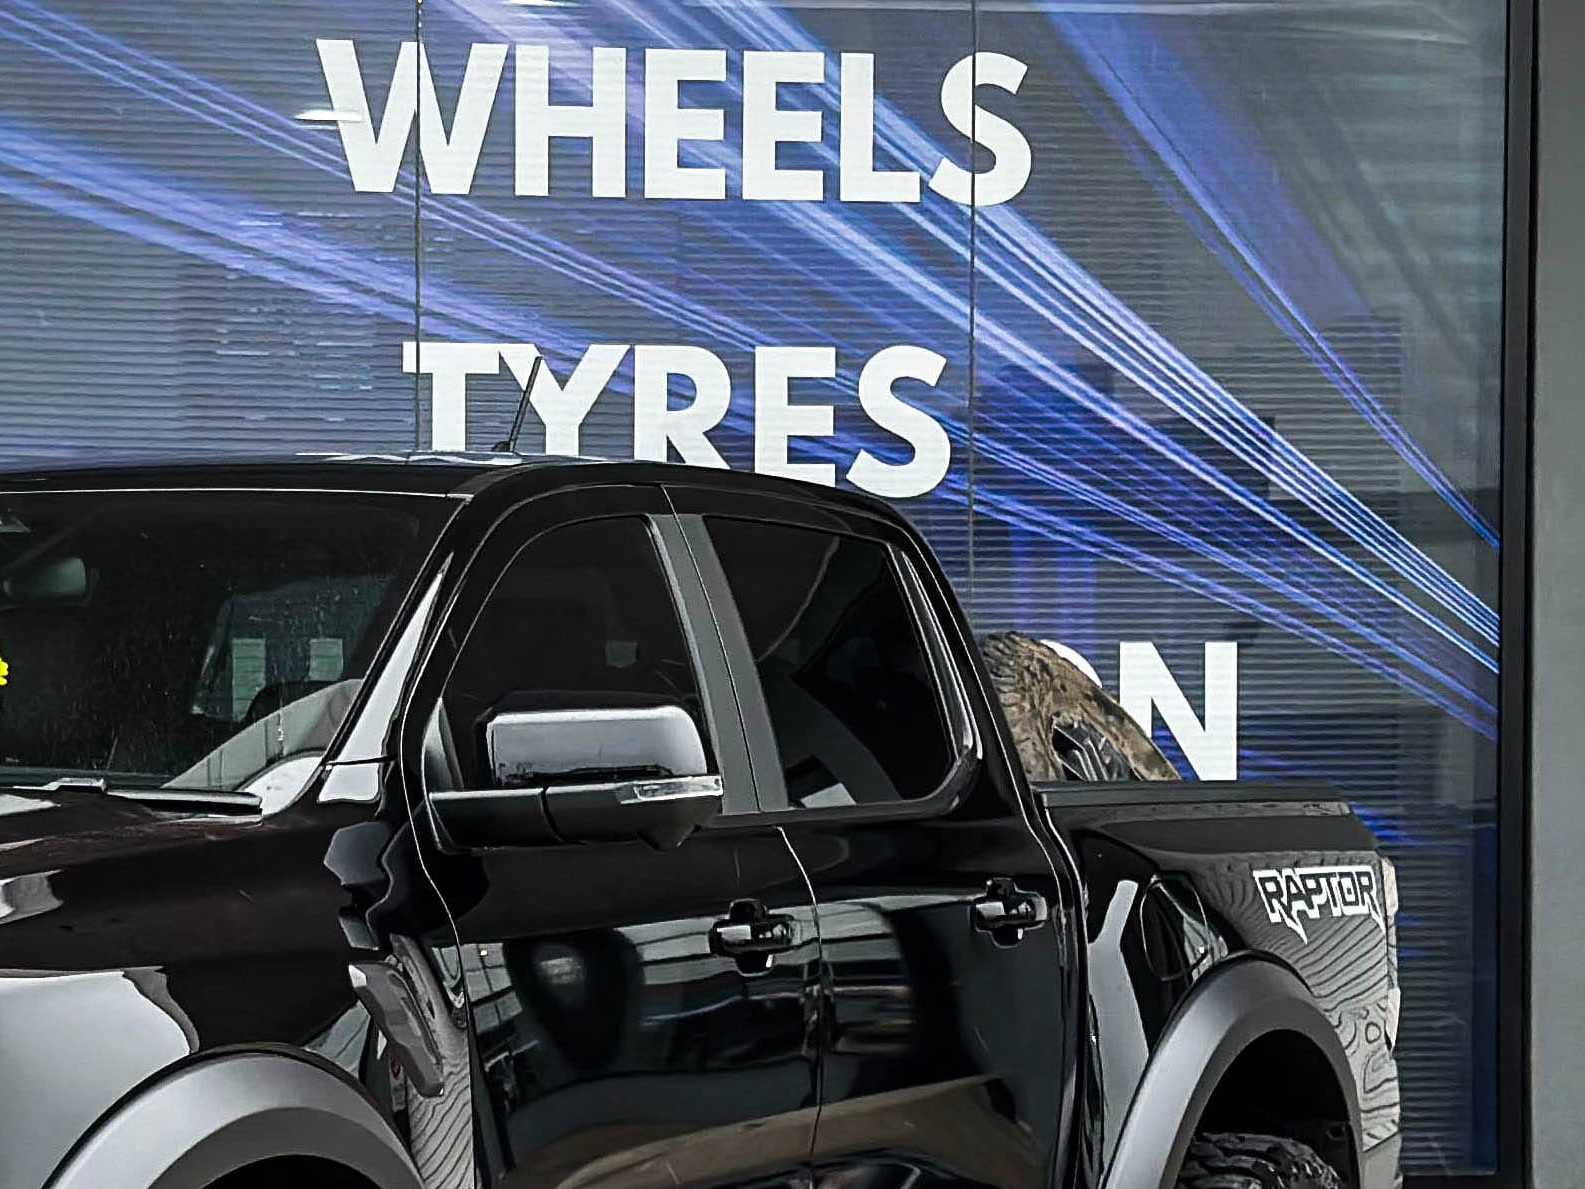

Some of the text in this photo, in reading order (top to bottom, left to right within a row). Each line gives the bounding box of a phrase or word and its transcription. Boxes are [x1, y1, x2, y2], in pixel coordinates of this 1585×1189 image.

[315, 39, 1033, 206] WHEELS
[402, 343, 952, 498] TYRES
[1253, 865, 1386, 944] RAPTOR
